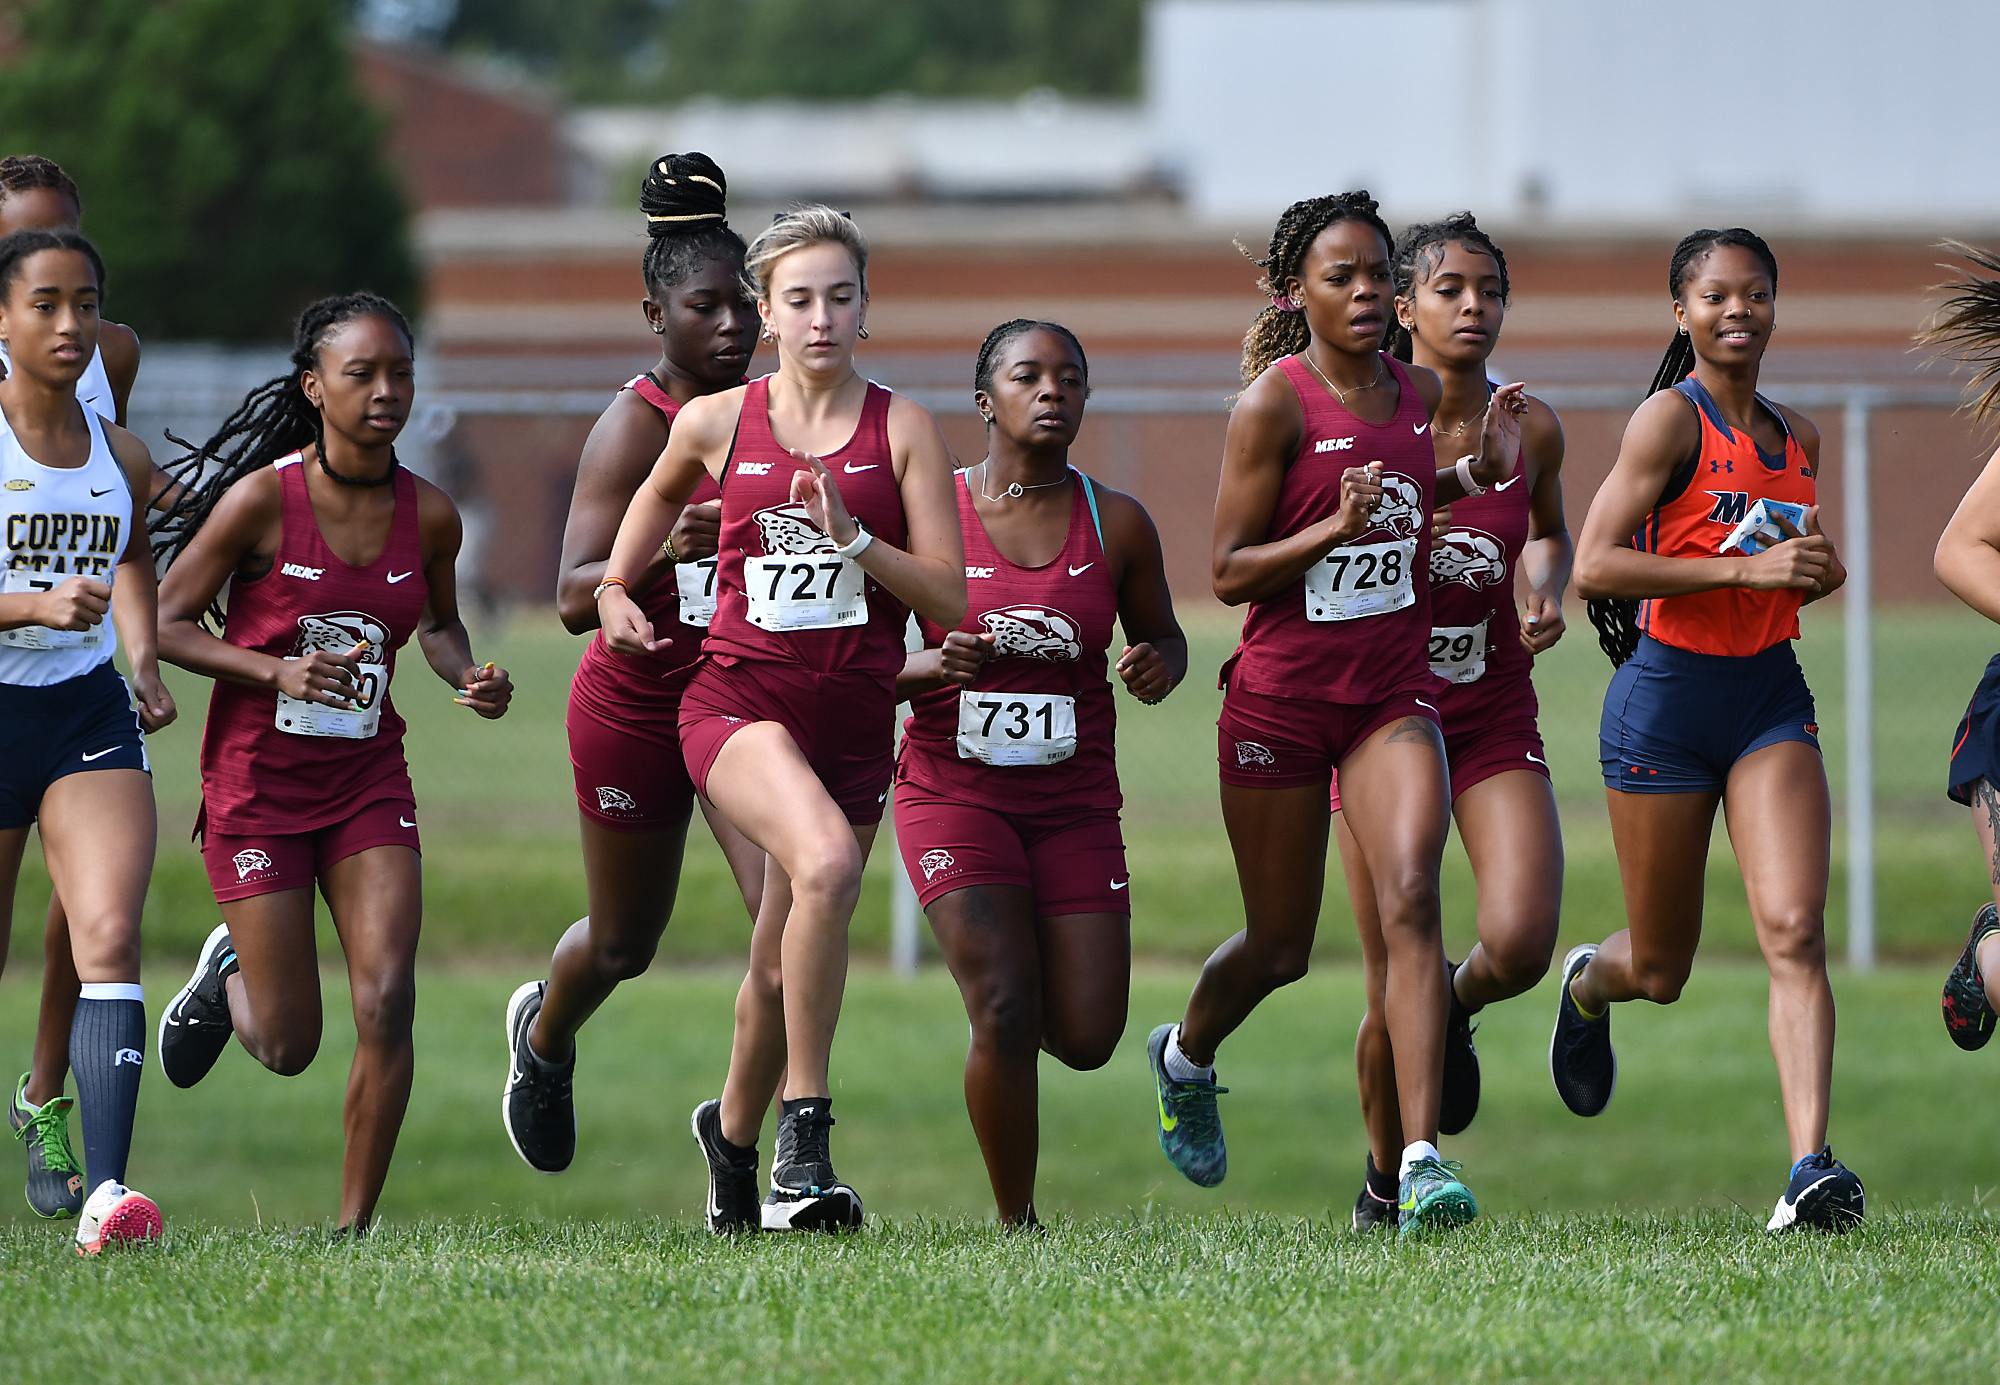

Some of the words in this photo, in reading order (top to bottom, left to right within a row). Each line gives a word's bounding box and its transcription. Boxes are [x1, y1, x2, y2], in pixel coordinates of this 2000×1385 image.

[1314, 436, 1357, 454] MEAC
[6, 513, 121, 554] COPPIN
[281, 562, 326, 581] MEAC
[763, 562, 843, 601] 727
[1326, 549, 1402, 592] 728
[977, 700, 1053, 740] 731
